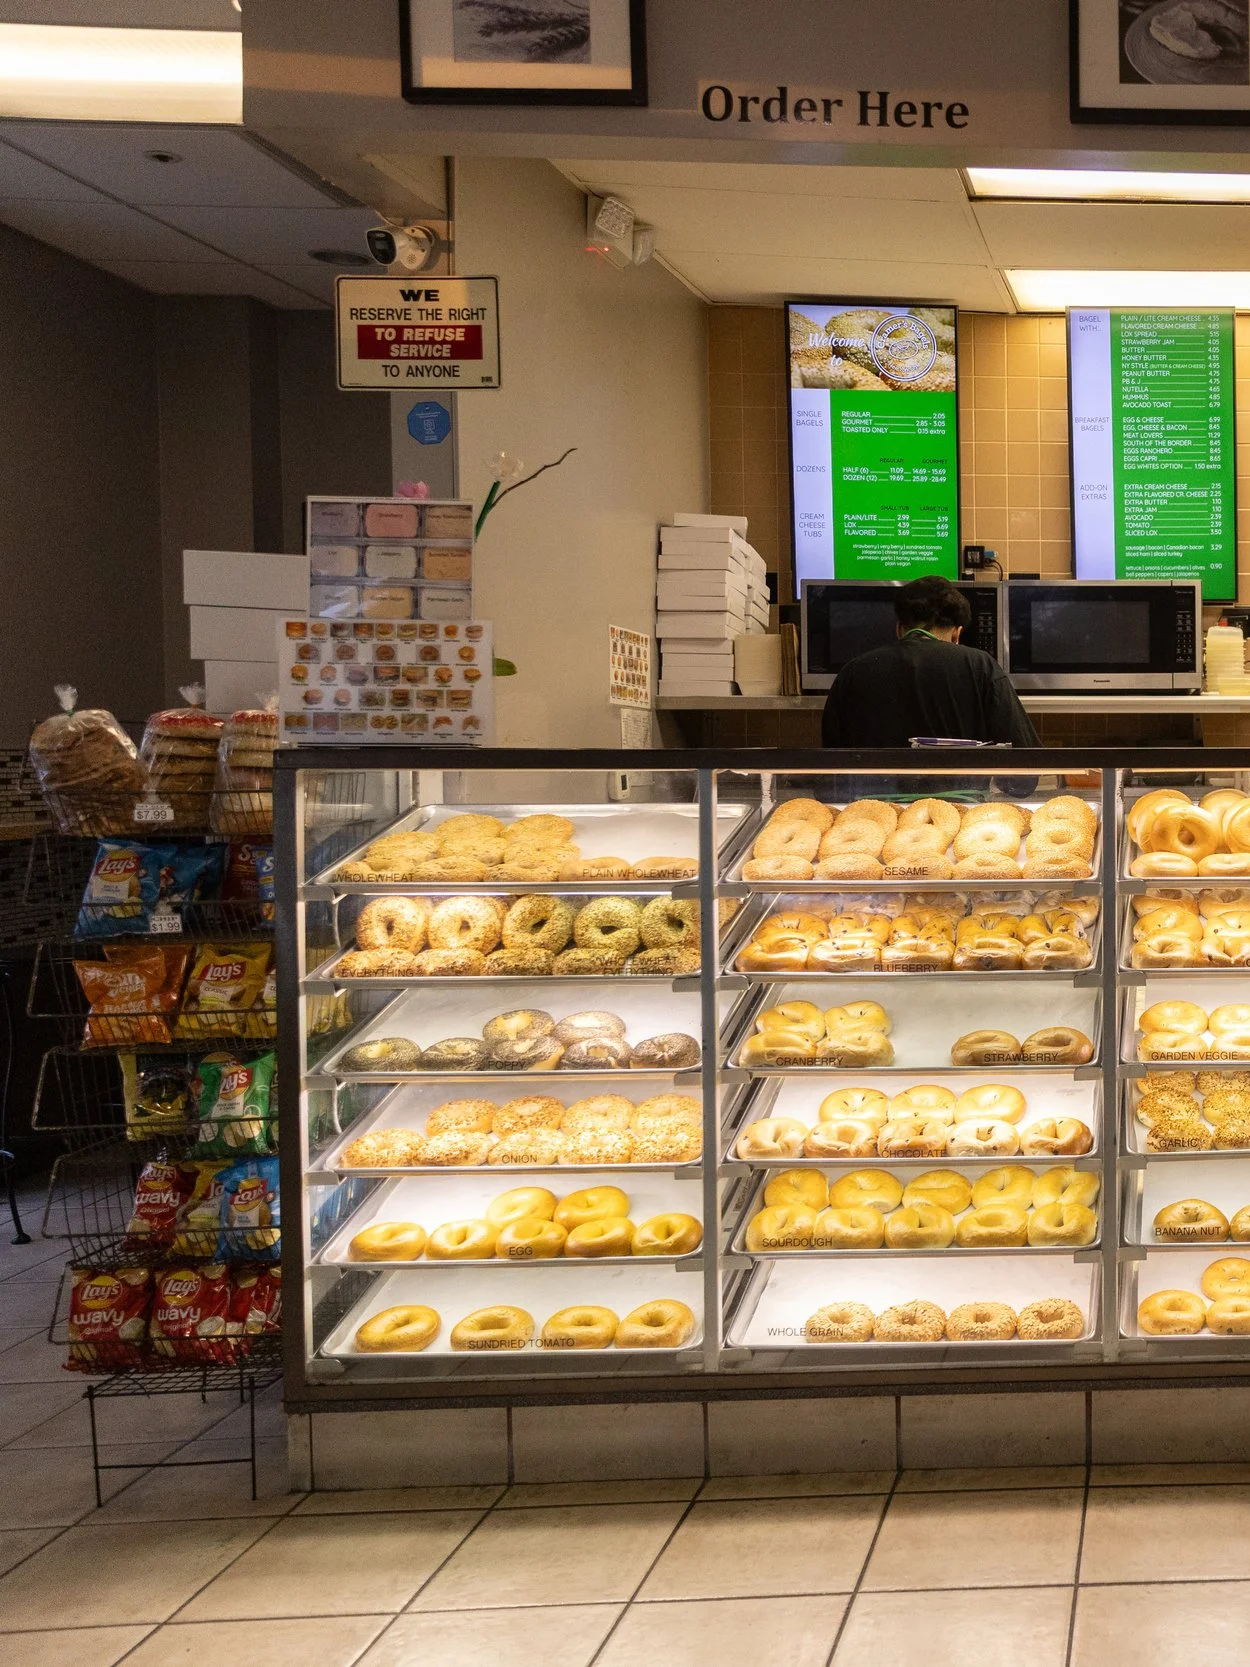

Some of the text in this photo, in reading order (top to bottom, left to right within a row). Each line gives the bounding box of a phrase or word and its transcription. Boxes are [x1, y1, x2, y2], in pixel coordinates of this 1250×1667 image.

[701, 85, 970, 129] Order Here
[400, 290, 439, 301] WE
[351, 308, 487, 320] RESERVE THE RIGHT
[375, 328, 465, 341] TO REFUSE
[910, 323, 930, 349] Bagels
[808, 333, 865, 347] Welcome
[390, 345, 451, 357] SERVICE
[830, 355, 842, 367] to
[382, 365, 460, 377] TO ANYONE
[136, 810, 168, 820] $7.99
[100, 856, 138, 875] Lay's
[582, 869, 696, 879] PLAIN WHOLEWHEAT
[885, 867, 928, 875] SESAME
[334, 873, 414, 883] WHOLEWHEAT
[152, 922, 180, 932] $1.99
[207, 965, 242, 981] Lay's
[341, 968, 414, 978] EVERYTHING
[874, 964, 938, 973] BLUEBERRY
[984, 1053, 1058, 1062] STRAWBERRY
[1151, 1051, 1238, 1061] GARDEN VEGGIE
[488, 1060, 526, 1070] POPPY
[776, 1057, 843, 1066] CRANBERRY
[1159, 1138, 1198, 1148] GARLIC
[881, 1149, 947, 1158] CHOCOLATE
[501, 1154, 538, 1164] ONION
[1155, 1226, 1221, 1236] BANANA NUT
[762, 1237, 833, 1246] SOURDOUGH
[509, 1247, 533, 1256] EGG
[73, 1311, 125, 1326] wavy
[768, 1328, 844, 1336] WHOLE GRAIN
[469, 1338, 575, 1349] SUNDRIED TOMATO
